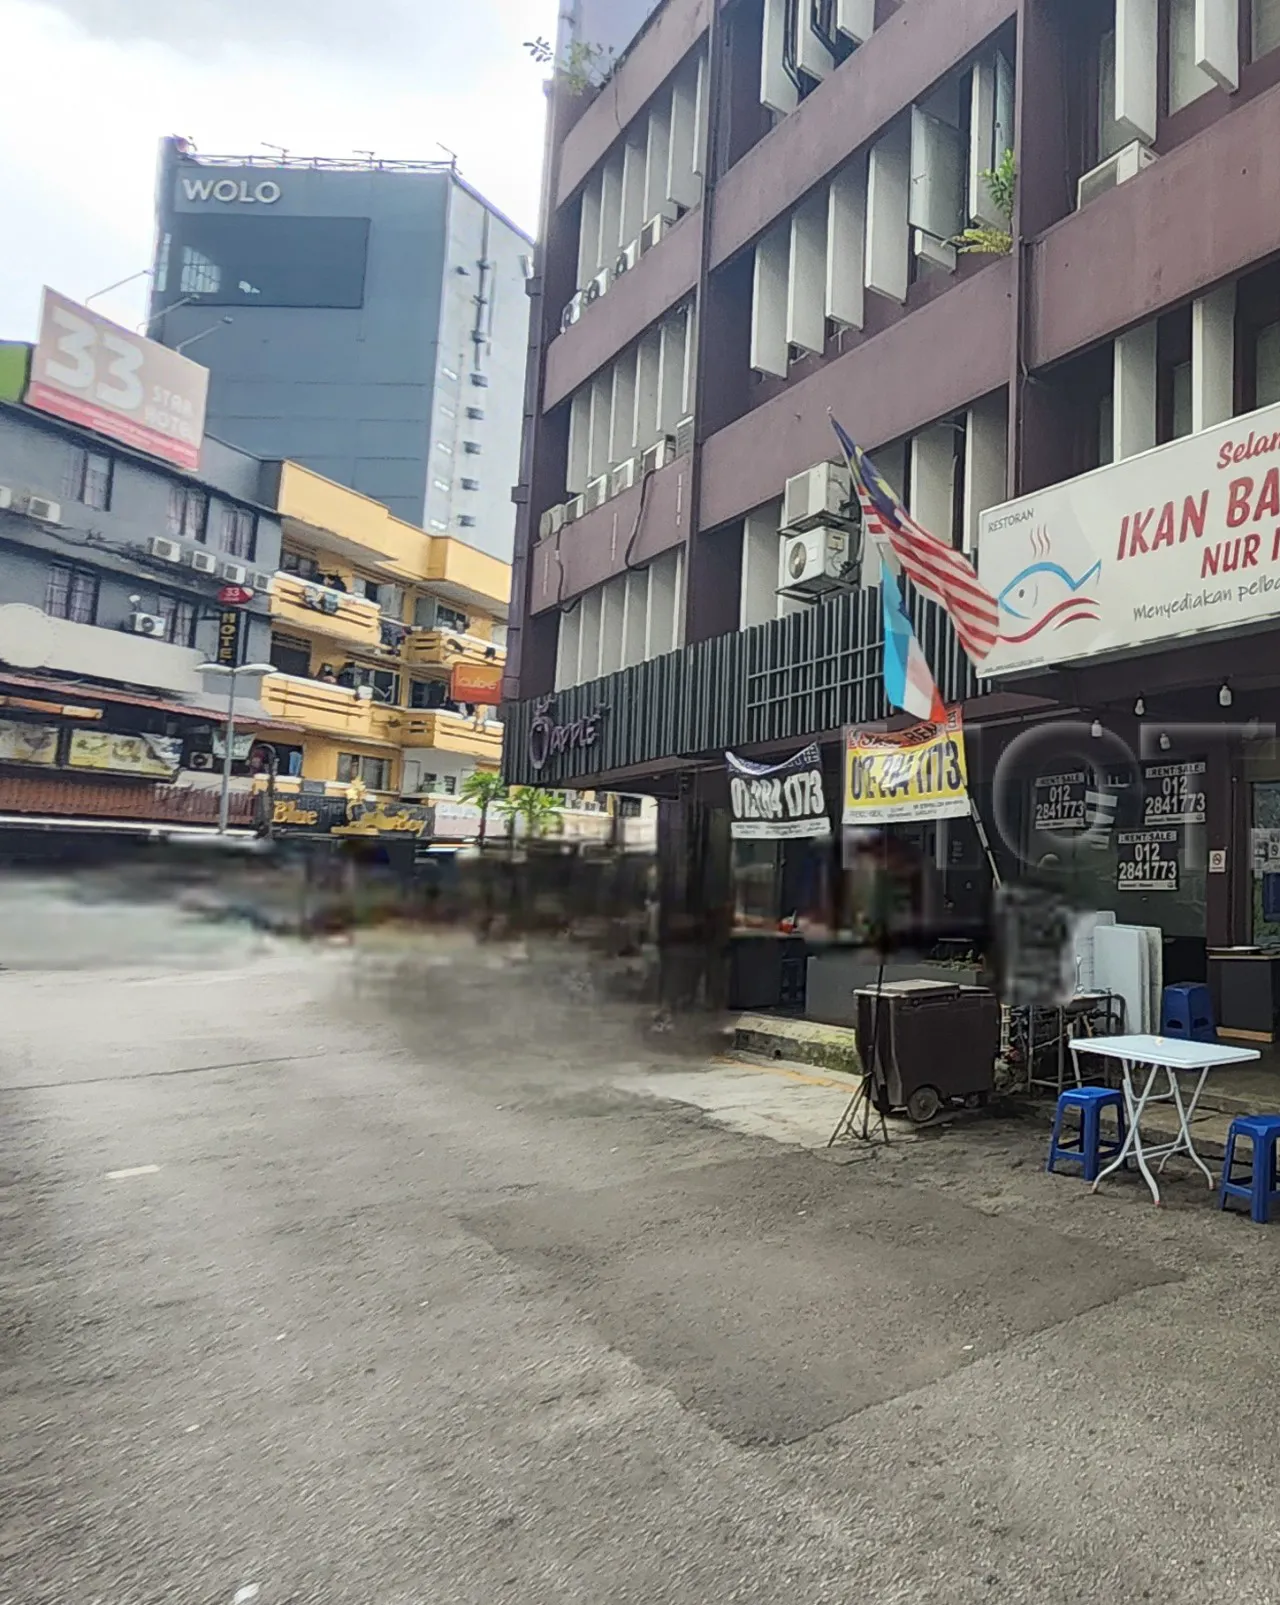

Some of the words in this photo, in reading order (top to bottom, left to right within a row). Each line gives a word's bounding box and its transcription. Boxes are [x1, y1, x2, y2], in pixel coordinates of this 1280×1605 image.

[182, 179, 281, 204] WOLO
[45, 305, 145, 411] 33
[988, 508, 1034, 533] RESTORAN
[1116, 489, 1210, 562] IKAN
[1200, 533, 1261, 579] NUR
[1133, 588, 1232, 621] Menyediakan
[1050, 785, 1071, 802] 012
[1162, 776, 1188, 795] 012
[1036, 800, 1085, 820] 2841773
[1145, 793, 1206, 815] 2841773
[1135, 843, 1160, 861] 012
[1119, 861, 1177, 880] 2841773
